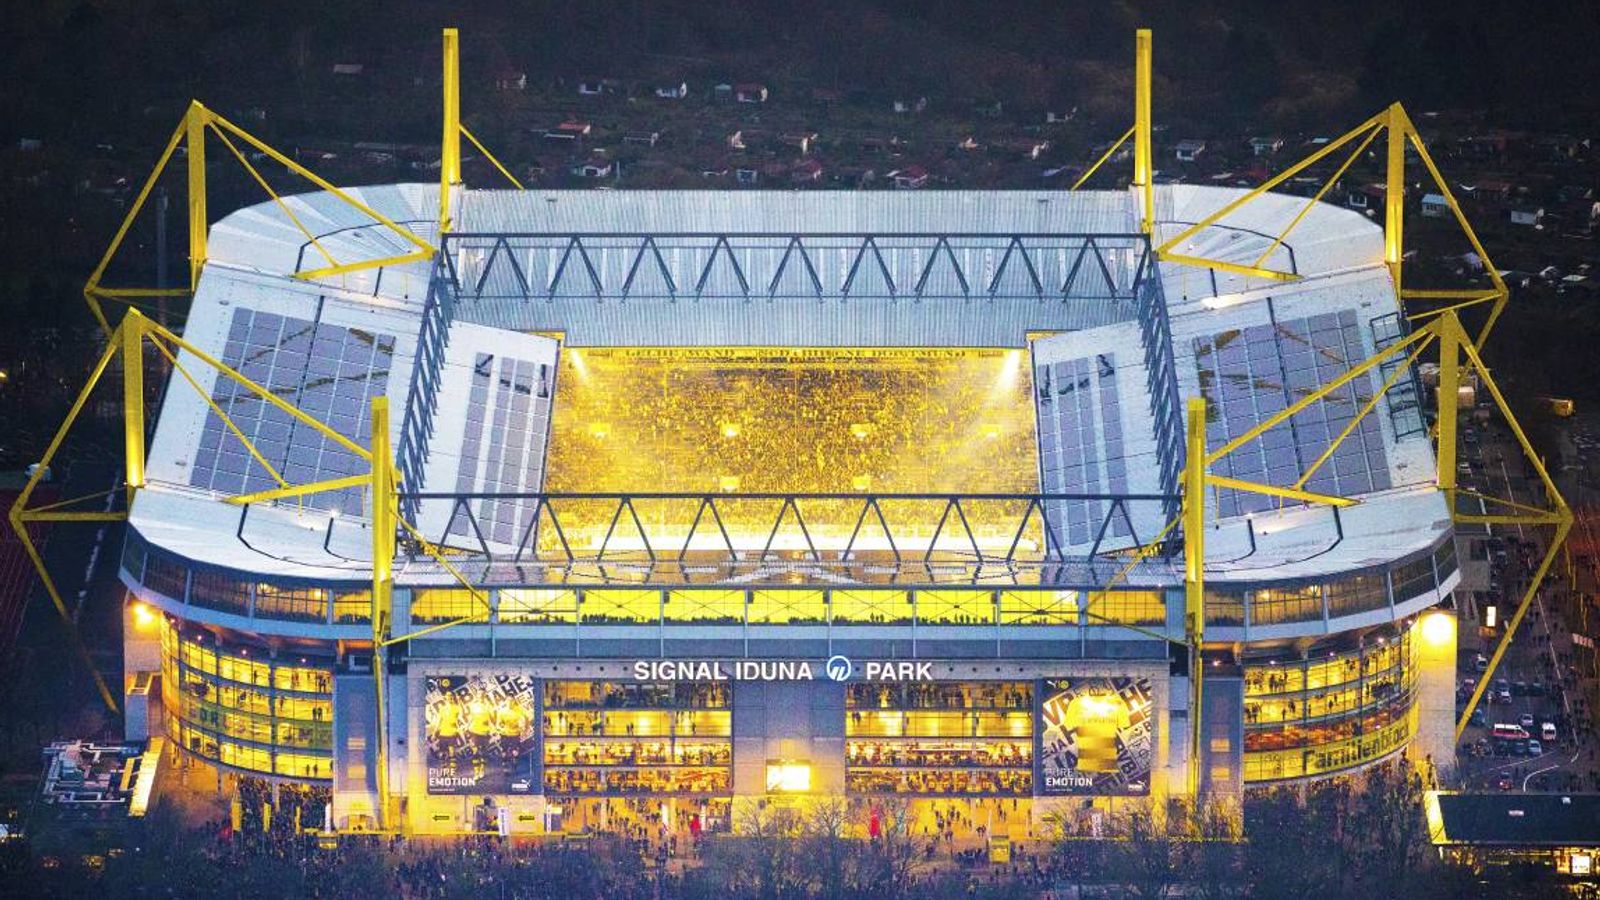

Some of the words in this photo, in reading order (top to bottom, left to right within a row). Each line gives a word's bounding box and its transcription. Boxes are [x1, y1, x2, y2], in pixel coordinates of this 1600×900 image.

[633, 661, 728, 681] SIGNAL
[735, 661, 813, 681] IDUNA
[866, 662, 933, 681] PARK
[429, 767, 457, 777] PURE
[429, 777, 476, 787] EMOTION
[1045, 777, 1093, 787] EMOTION
